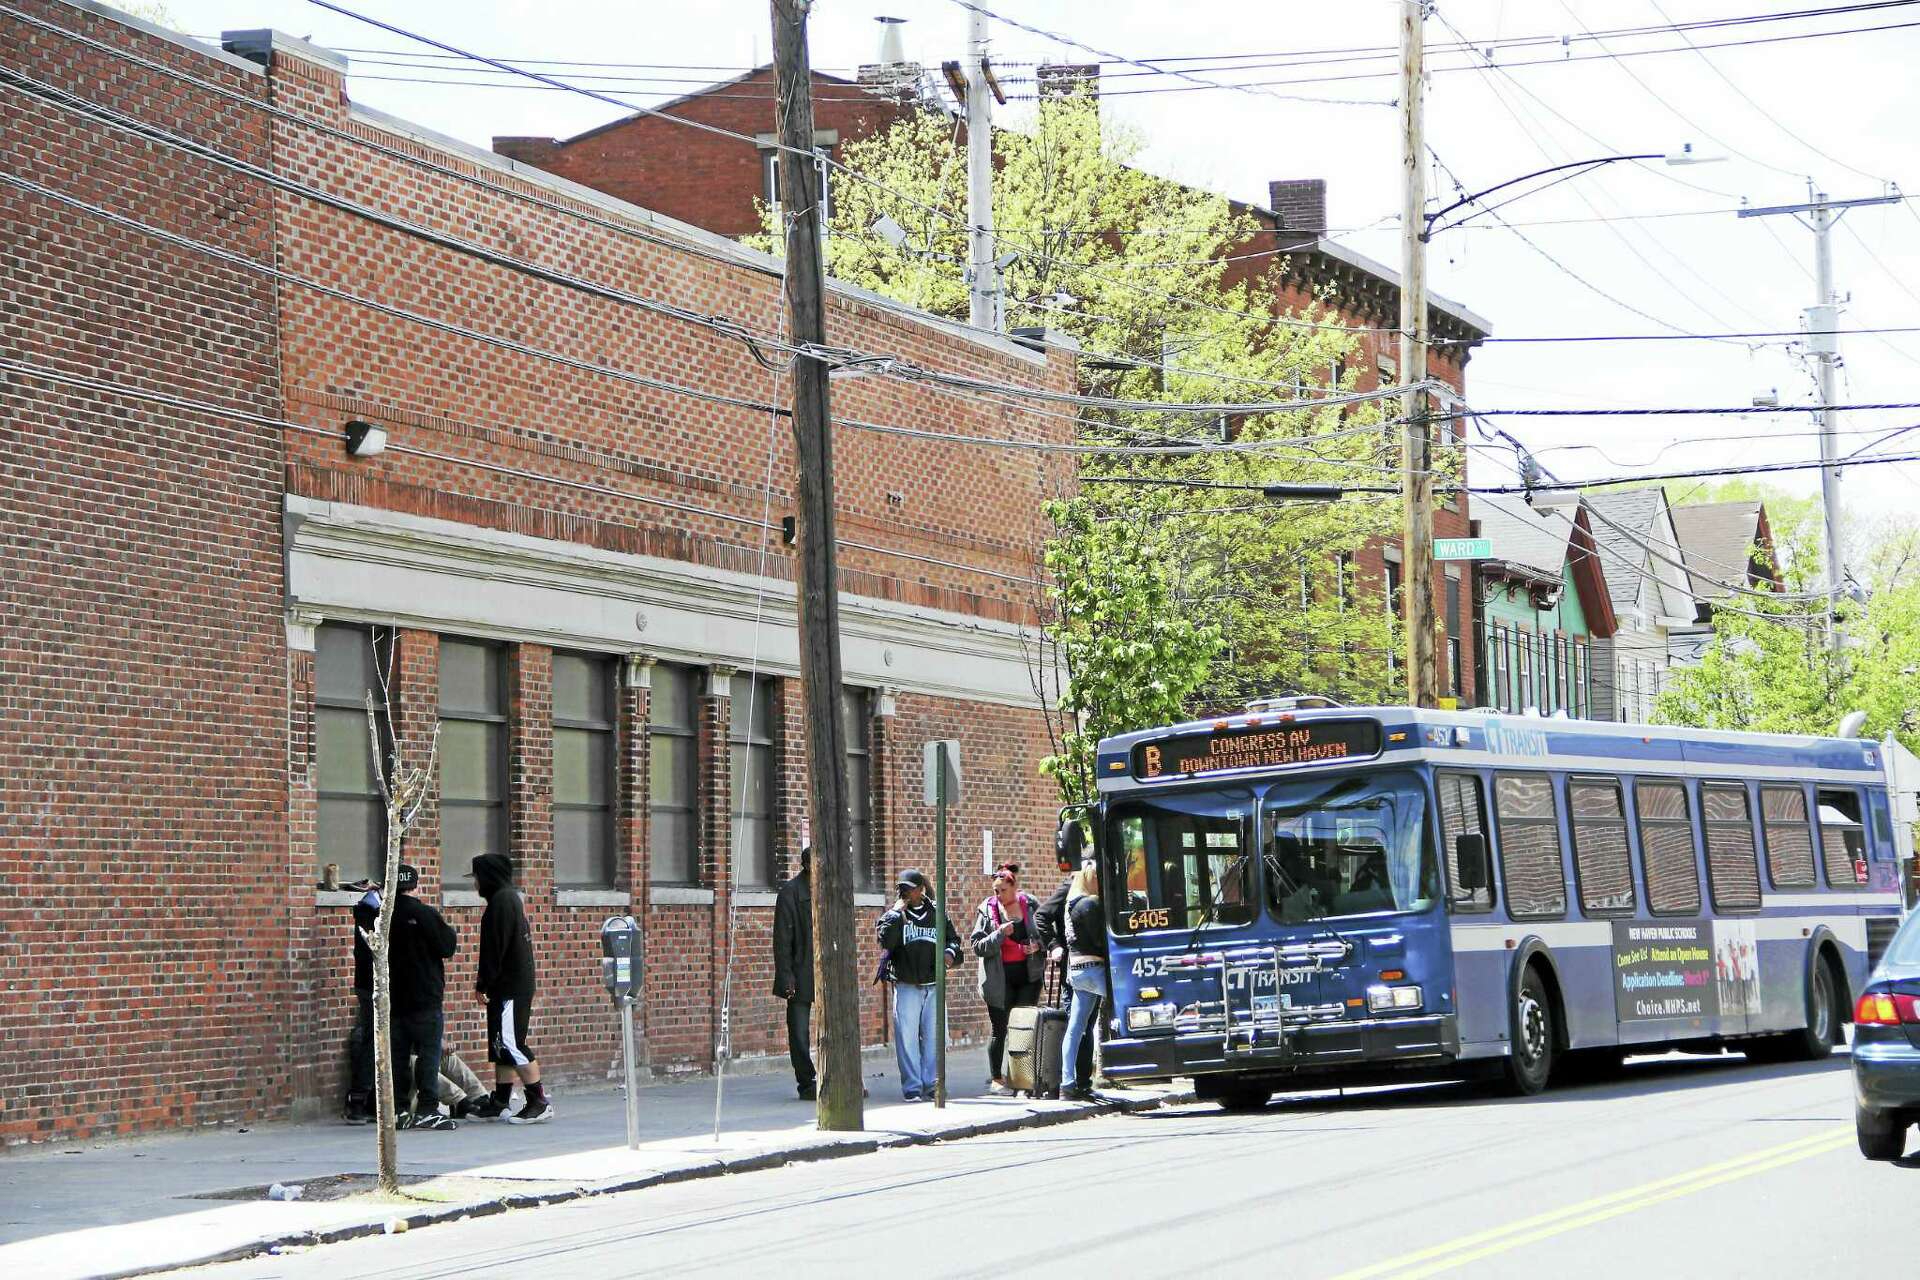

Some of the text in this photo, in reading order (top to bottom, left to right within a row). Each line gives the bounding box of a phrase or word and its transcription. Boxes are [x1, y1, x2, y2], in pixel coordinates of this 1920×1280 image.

[1440, 541, 1475, 557] WARD
[1209, 729, 1311, 755] CONGRESS AV
[1145, 745, 1162, 777] B
[1179, 742, 1347, 774] DOWNTOWN NEW HAVEN
[399, 871, 412, 882] OLF
[1128, 910, 1169, 930] 6405
[903, 920, 937, 945] PANTHER
[1132, 957, 1169, 978] 452
[1617, 954, 1631, 968] Come
[1677, 947, 1692, 965] Open
[1691, 947, 1709, 961] House
[1622, 971, 1657, 992] Application
[1636, 998, 1702, 1016] Choice.NHPS.net
